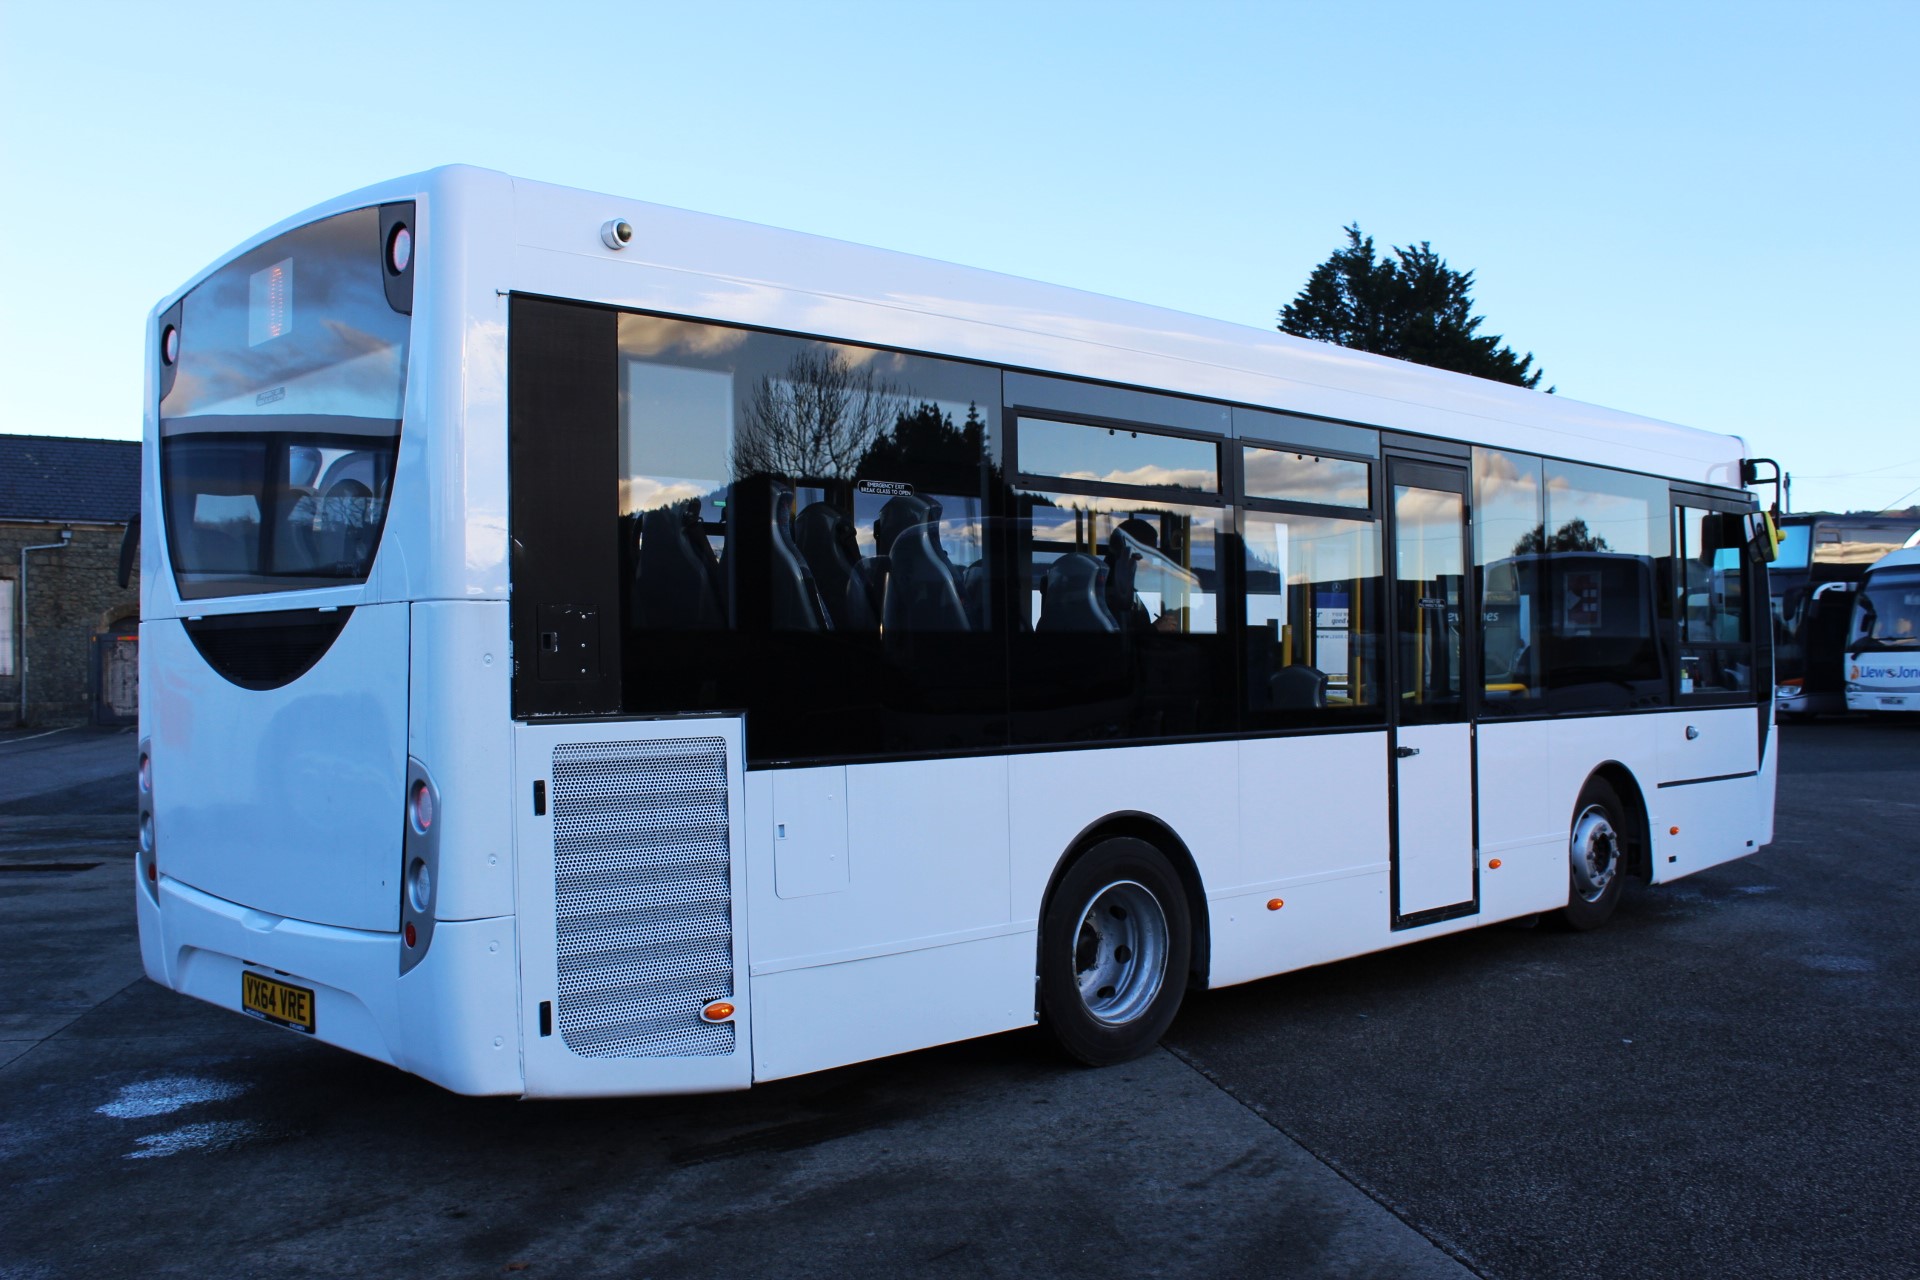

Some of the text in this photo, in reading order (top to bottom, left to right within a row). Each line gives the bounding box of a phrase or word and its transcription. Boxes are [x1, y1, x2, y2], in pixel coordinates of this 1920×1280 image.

[867, 482, 894, 490] EMERGENCY
[246, 976, 306, 1022] YX64 VRE
